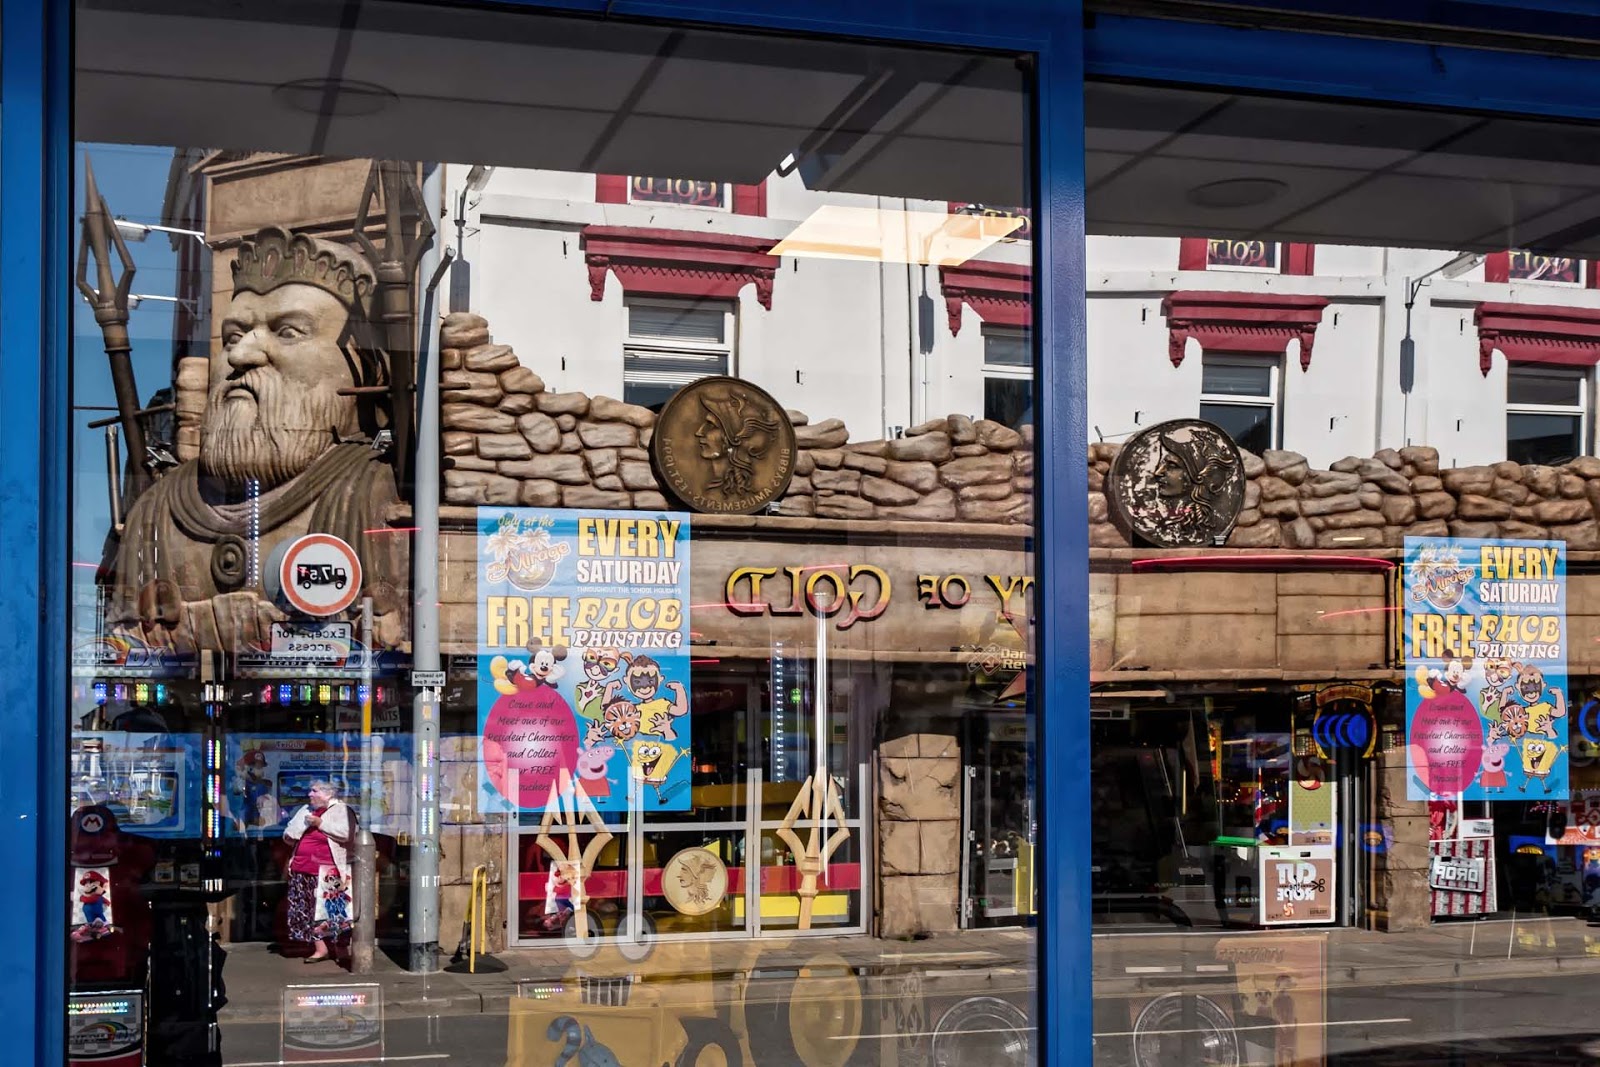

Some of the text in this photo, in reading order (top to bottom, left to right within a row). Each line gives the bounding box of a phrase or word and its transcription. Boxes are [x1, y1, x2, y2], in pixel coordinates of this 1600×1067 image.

[497, 513, 555, 530] Only at the
[577, 517, 681, 558] EVERY
[1480, 546, 1559, 580] EVERY
[576, 559, 681, 585] SATURDAY
[653, 587, 682, 595] HOLIDAYS
[1479, 582, 1559, 603] SATURDAY
[486, 595, 683, 648] FREE FACE
[572, 630, 682, 649] PAINTING
[1411, 613, 1560, 659] FREE FACE
[1476, 643, 1560, 659] PAINTING
[508, 699, 555, 709] Come and
[497, 715, 567, 729] Meet one of our
[488, 732, 576, 742] Resident Characters
[506, 748, 558, 759] and Collect
[530, 766, 555, 775] FREE
[519, 782, 550, 792] ouchers
